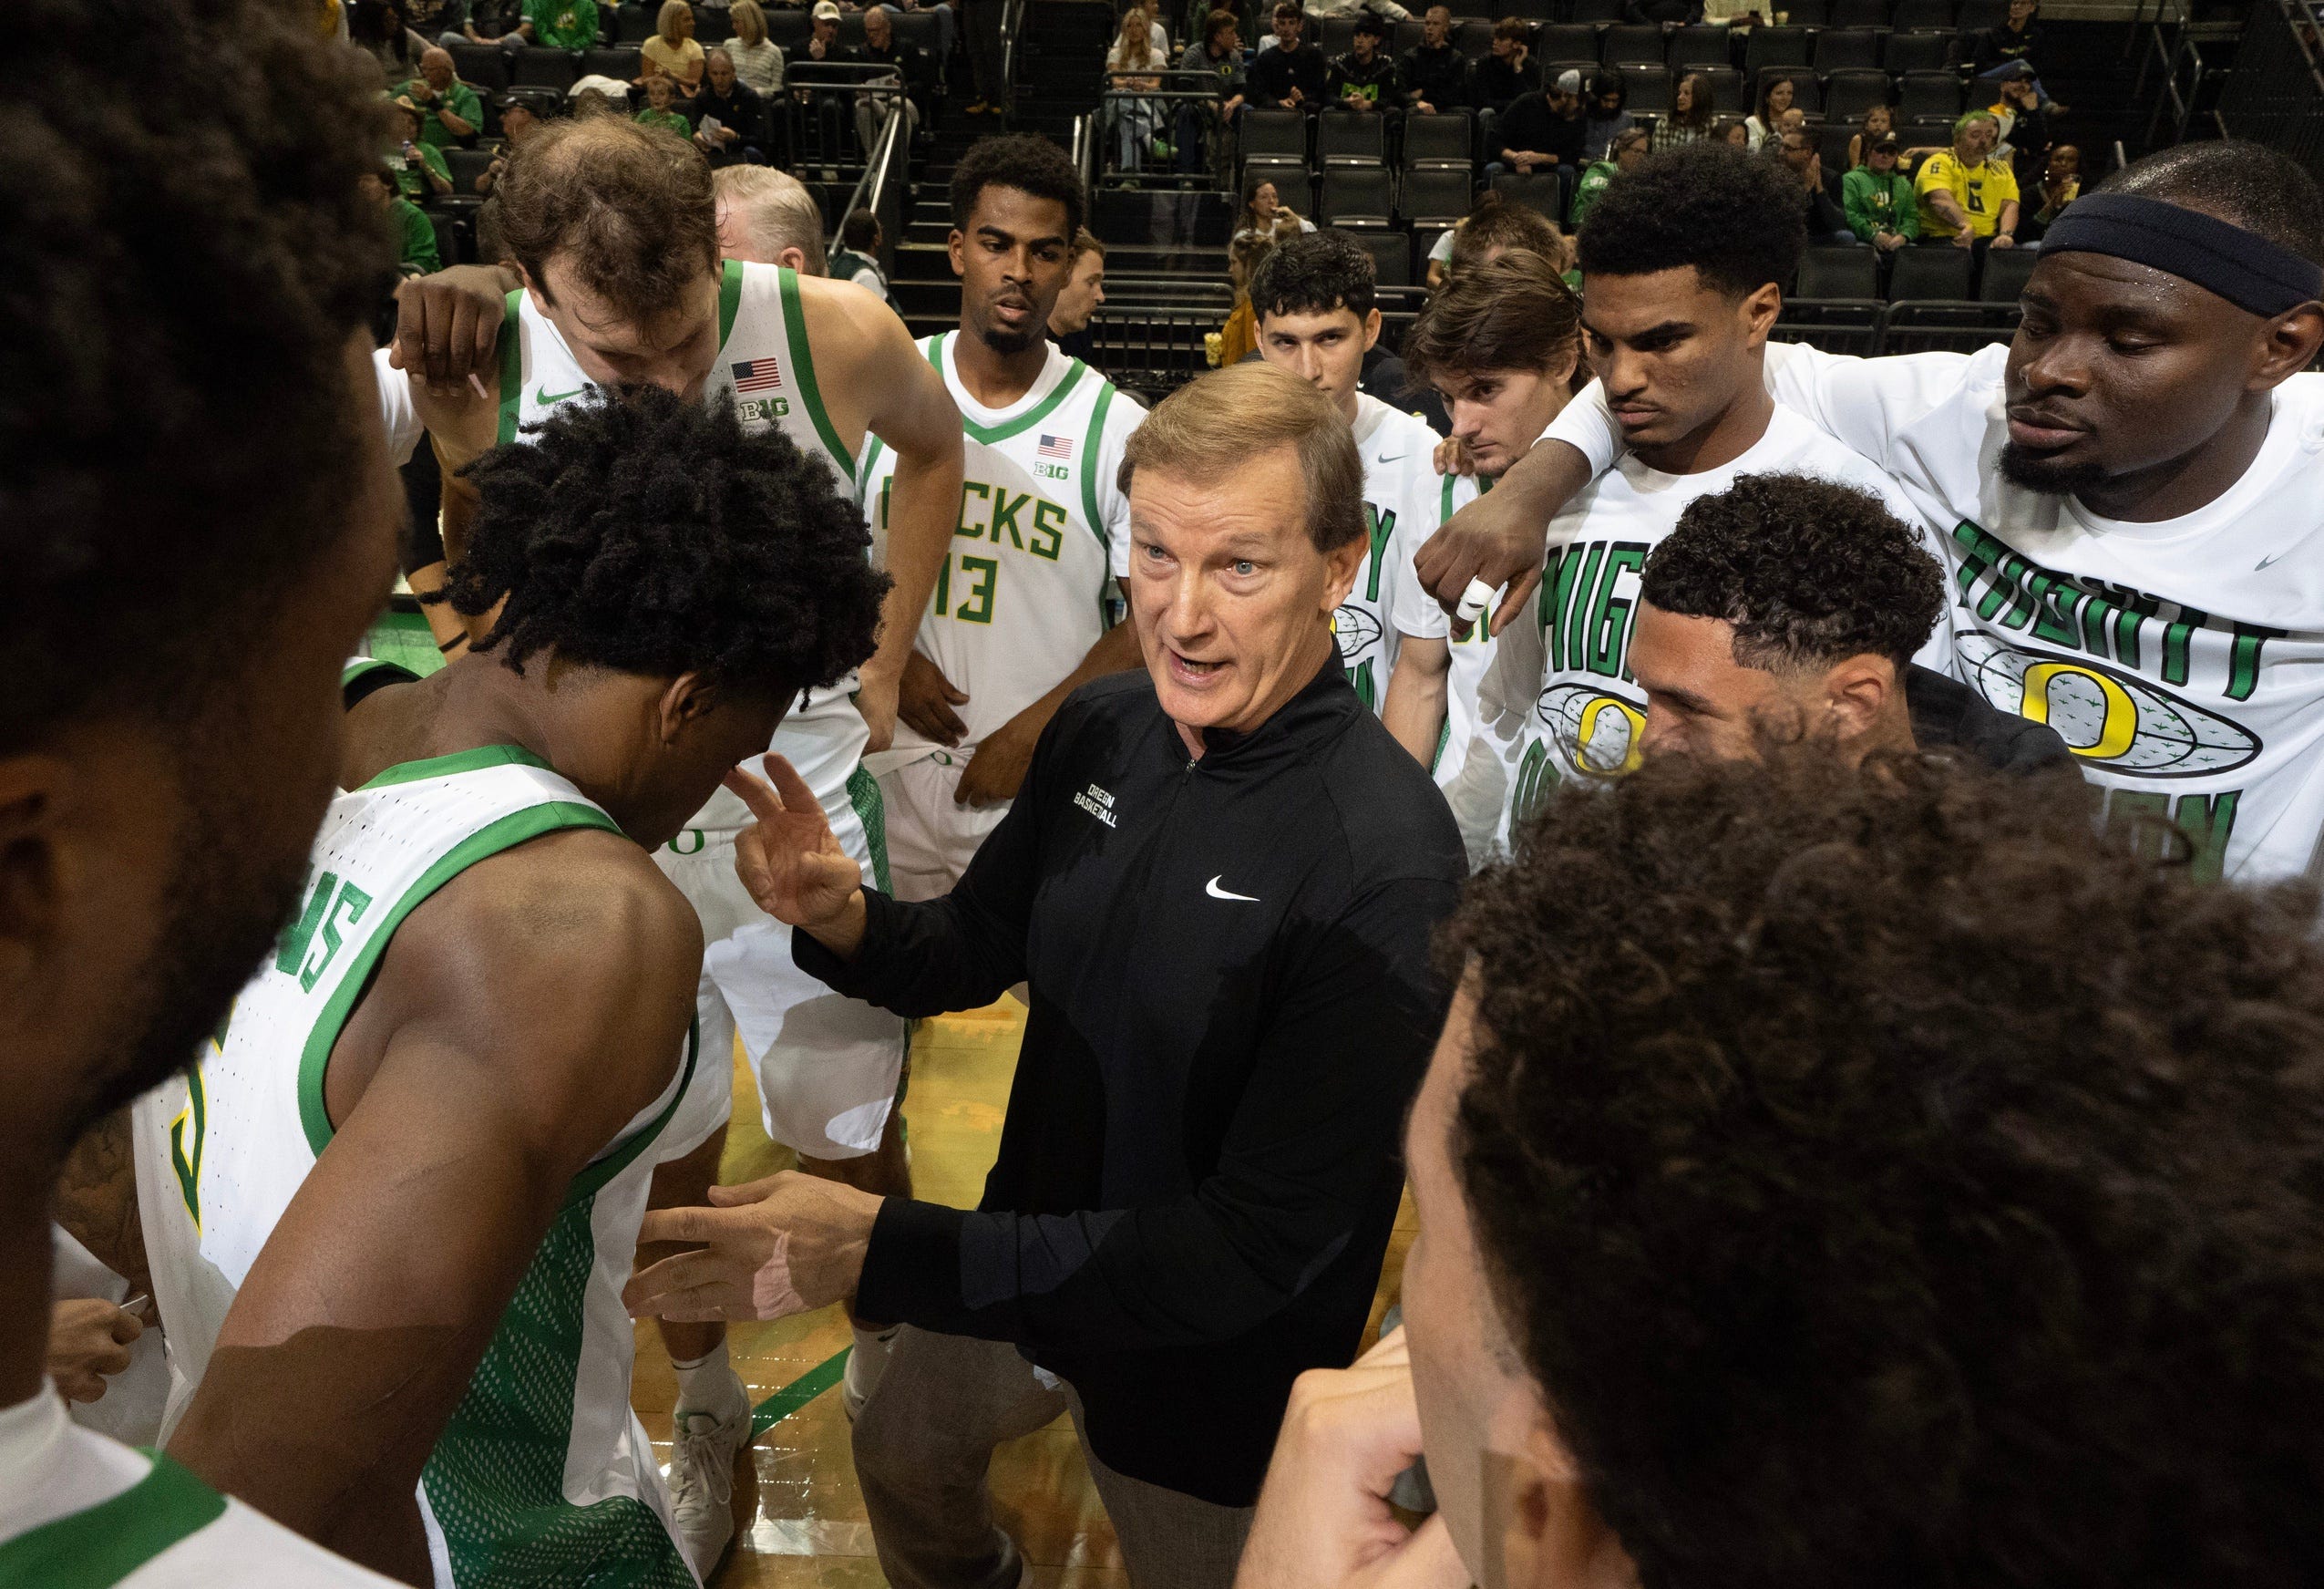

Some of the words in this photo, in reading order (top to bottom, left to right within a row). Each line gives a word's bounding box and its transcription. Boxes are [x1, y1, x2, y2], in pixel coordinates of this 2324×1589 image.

[1968, 181, 1986, 213] 6
[881, 475, 1068, 562] CKS
[933, 552, 999, 626] 13
[1538, 541, 1651, 684] MIG
[1074, 791, 1117, 829] BASKETALL
